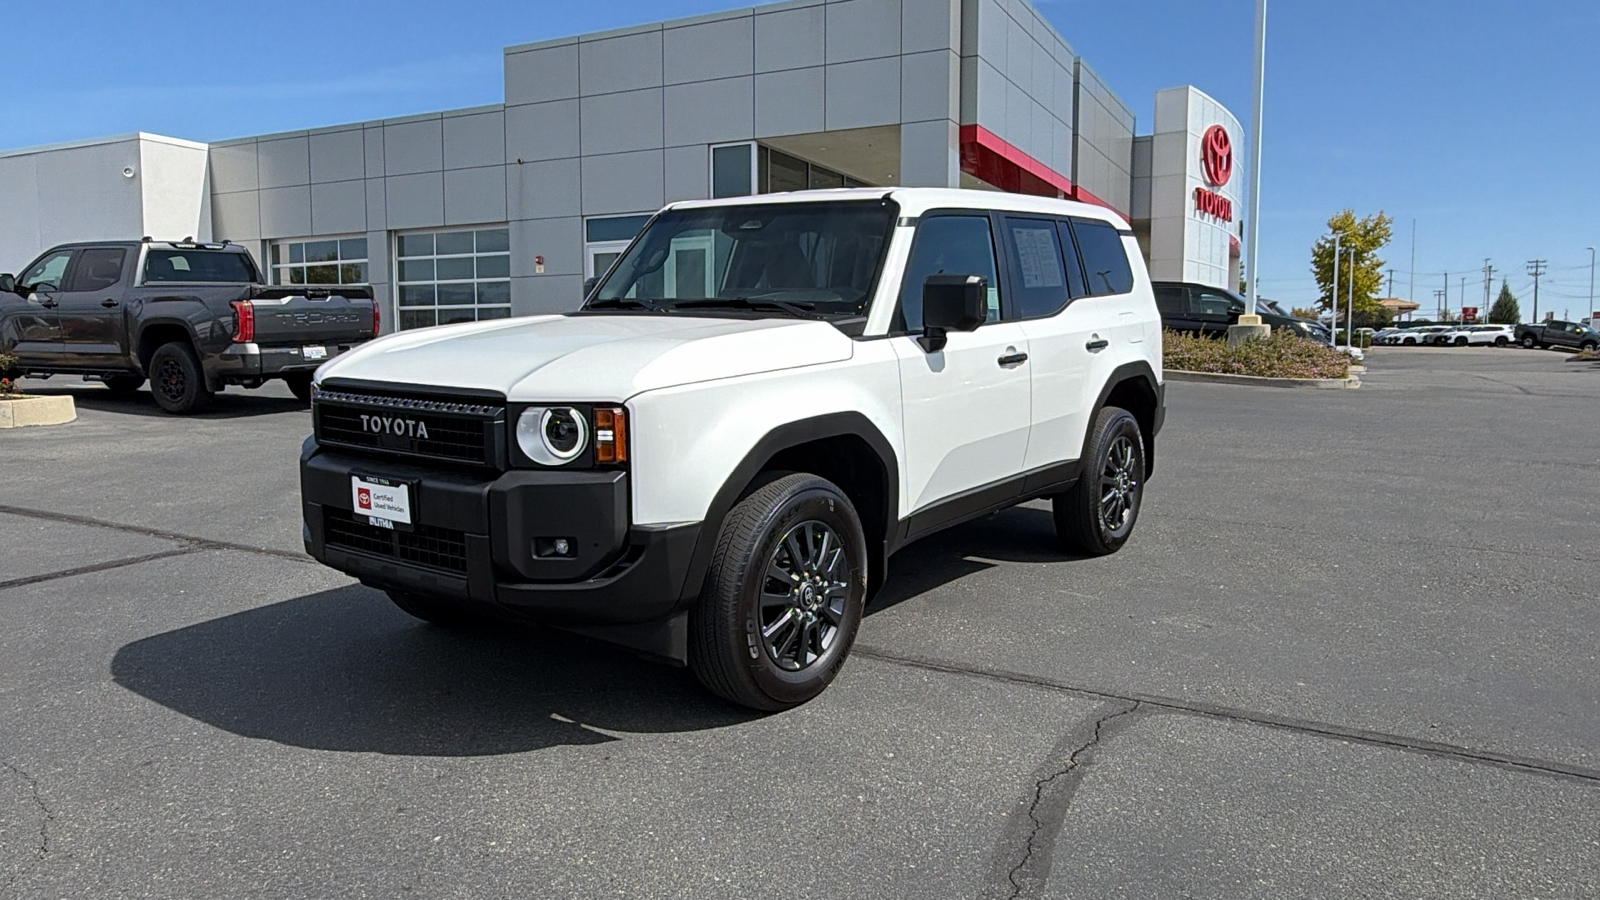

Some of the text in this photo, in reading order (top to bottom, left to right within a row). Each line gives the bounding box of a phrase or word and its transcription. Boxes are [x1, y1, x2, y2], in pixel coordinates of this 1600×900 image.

[1195, 187, 1232, 222] TOYOTA
[360, 414, 429, 439] TOYOTA
[365, 476, 379, 484] SINCE
[373, 493, 393, 502] Certified
[374, 502, 405, 513] Used Vehicles
